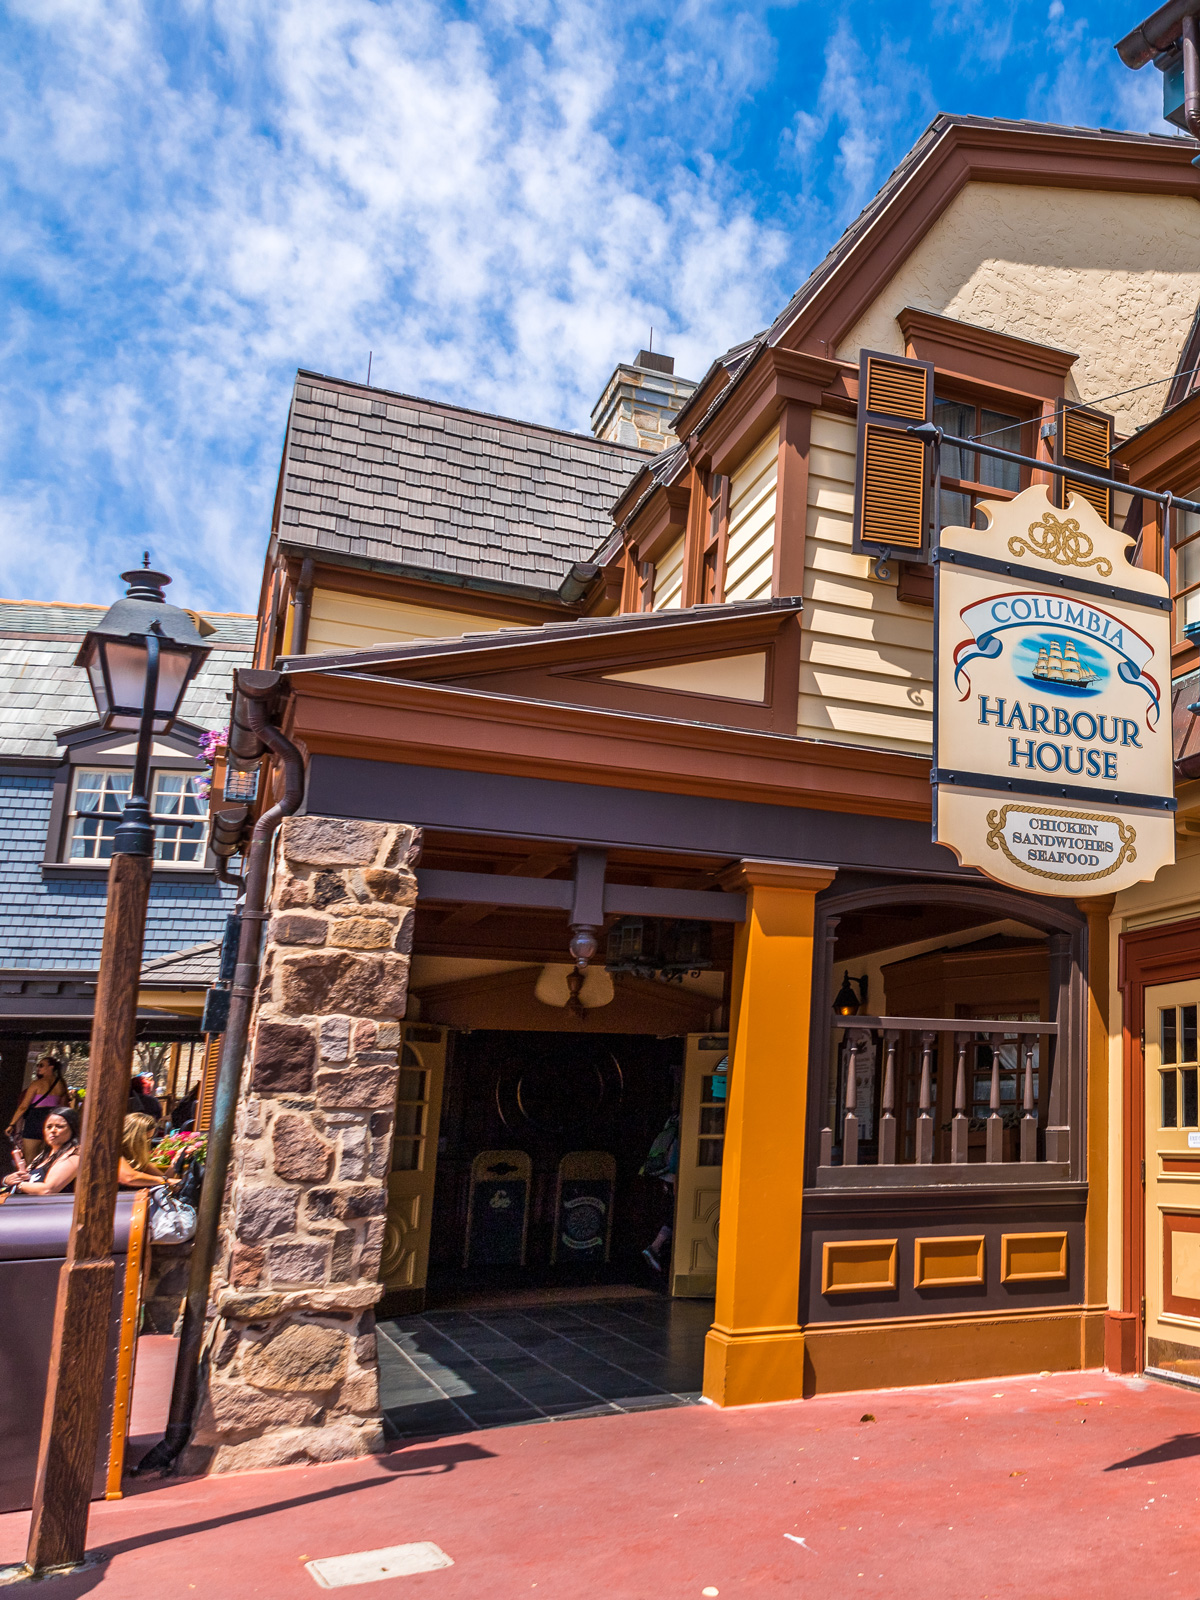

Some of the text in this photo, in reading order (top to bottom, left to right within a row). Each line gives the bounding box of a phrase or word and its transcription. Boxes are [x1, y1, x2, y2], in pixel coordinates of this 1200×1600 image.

[991, 598, 1125, 650] COLUMBIA
[978, 695, 1143, 749] HARBOUR
[1009, 737, 1119, 780] HOUSE
[1012, 832, 1114, 853] SANDWICHES
[1029, 818, 1099, 836] CHICKEN
[1028, 849, 1100, 867] SEAFOOD
